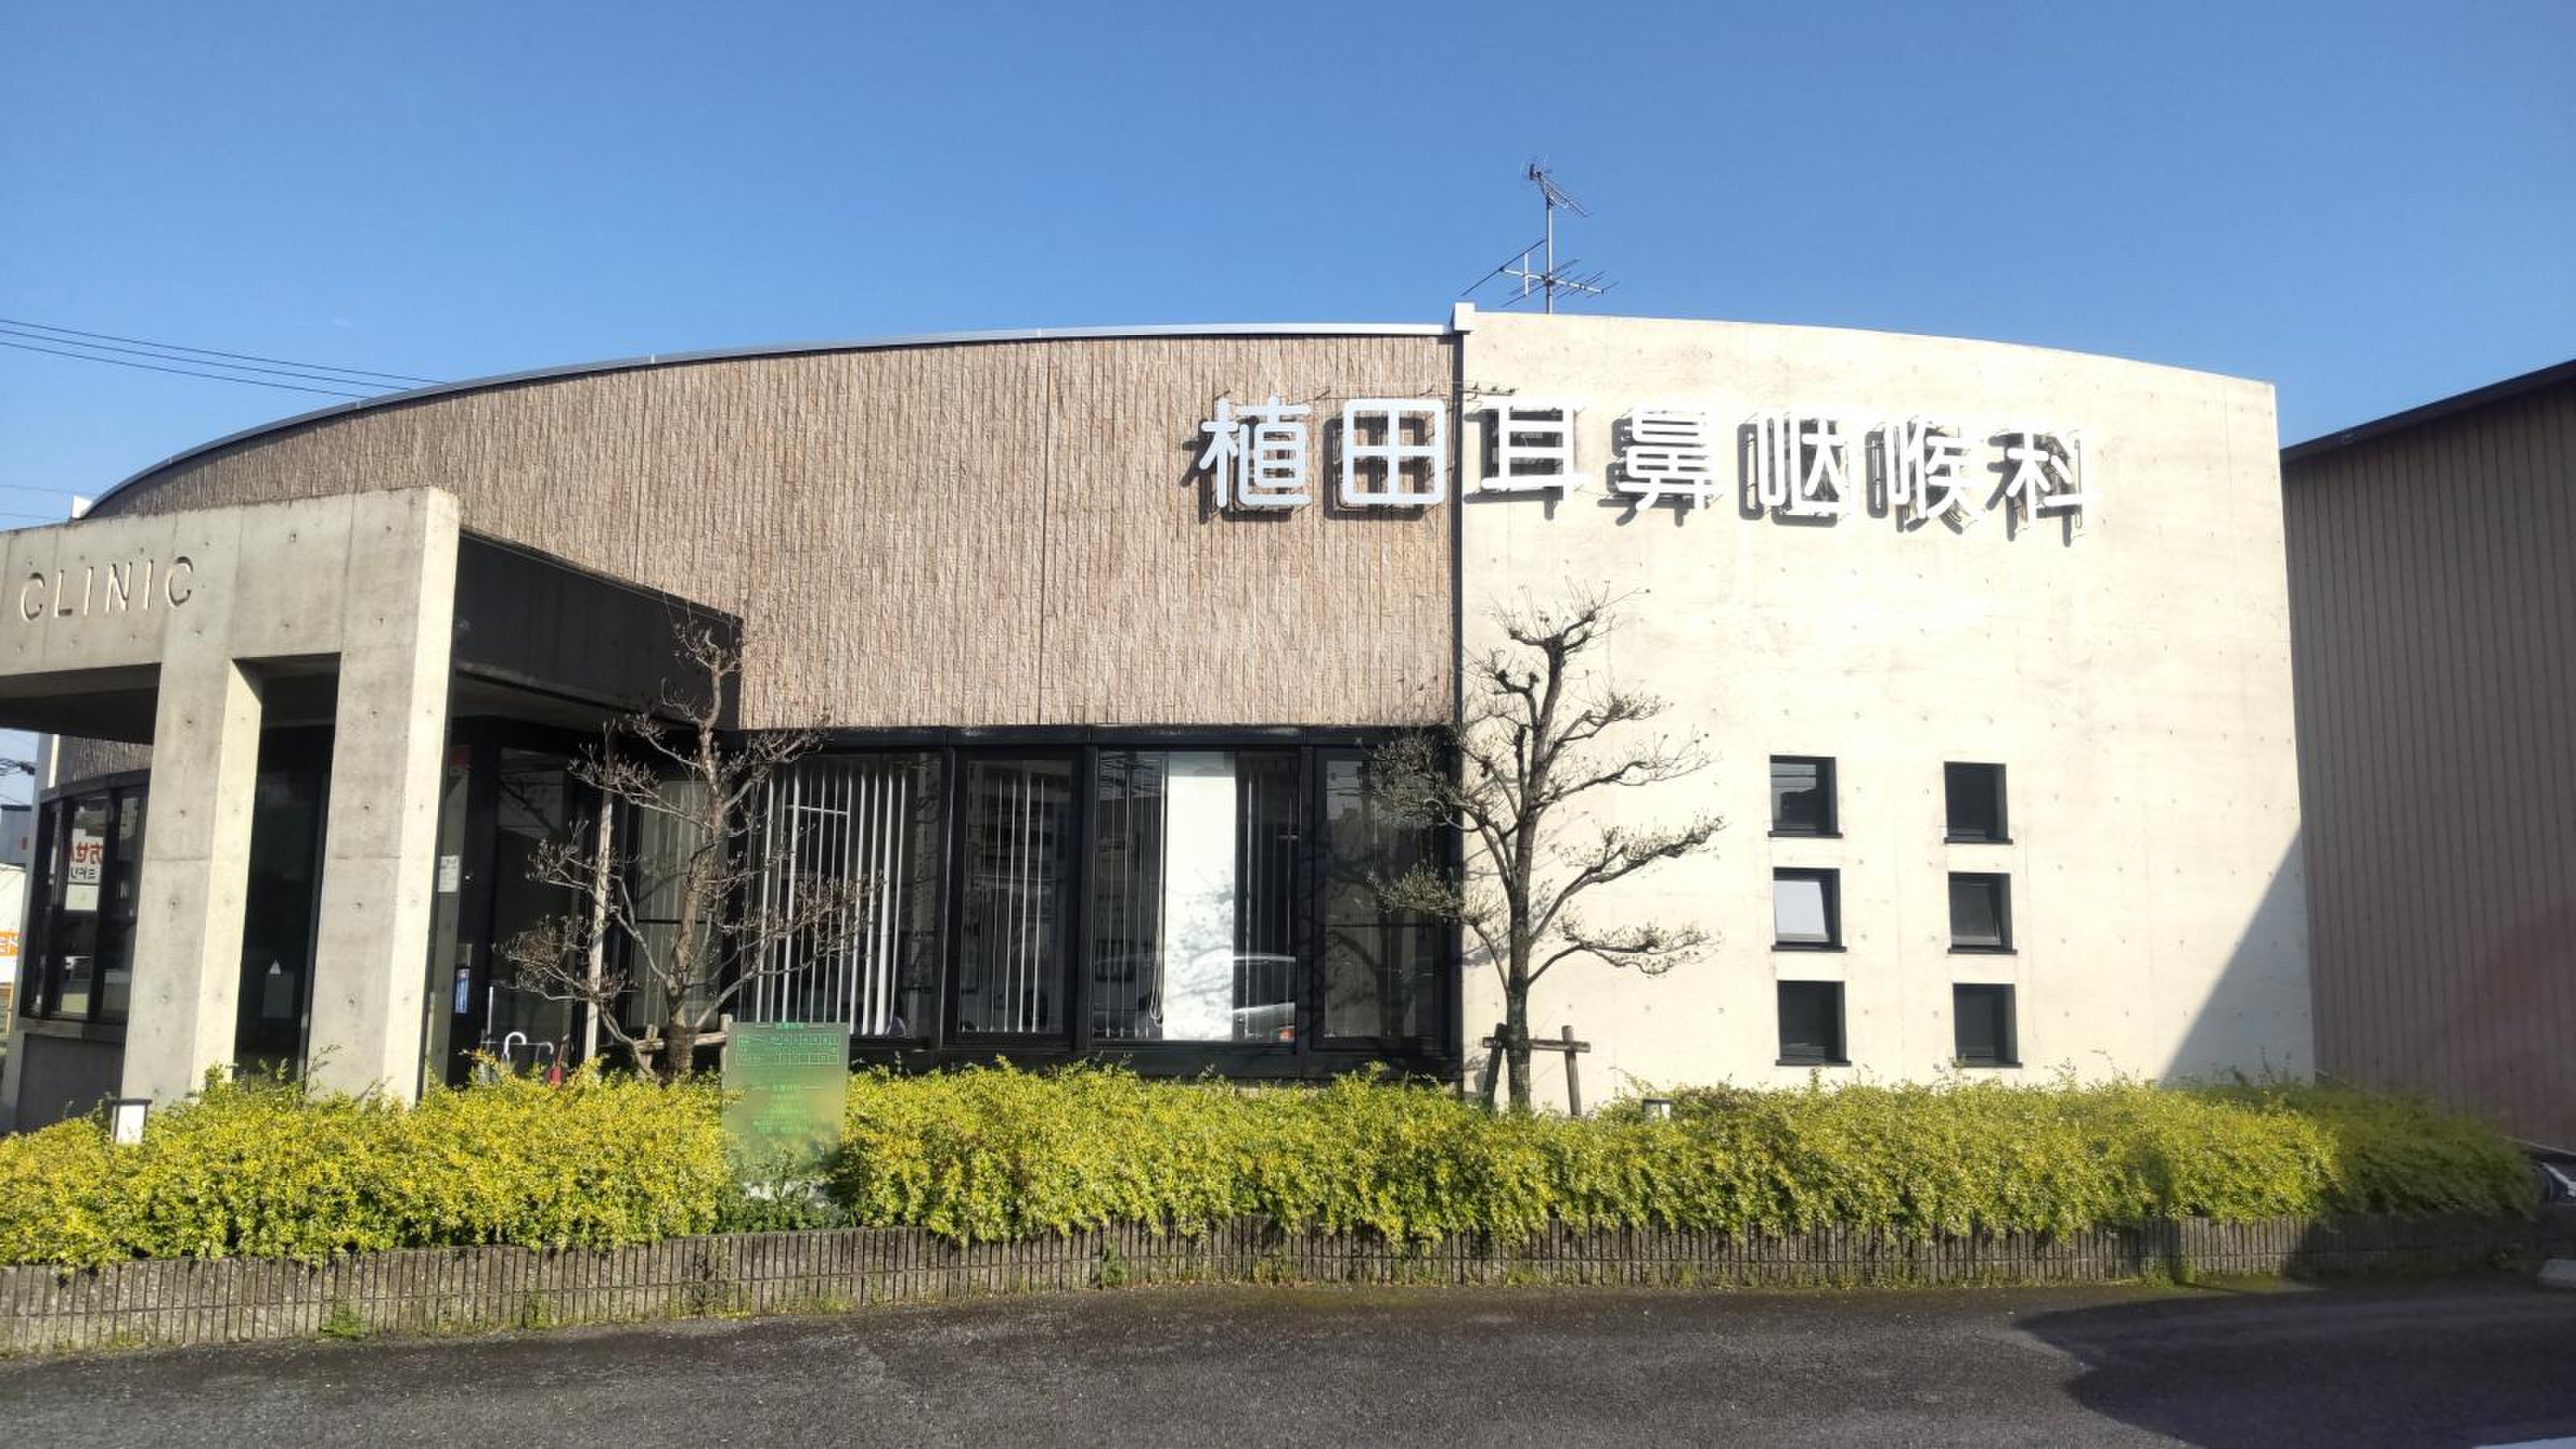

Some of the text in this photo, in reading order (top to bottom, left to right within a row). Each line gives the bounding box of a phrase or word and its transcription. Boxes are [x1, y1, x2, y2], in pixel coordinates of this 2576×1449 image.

[1198, 394, 2104, 525] 植田耳鼻咽喉科
[20, 556, 194, 622] CLINIC
